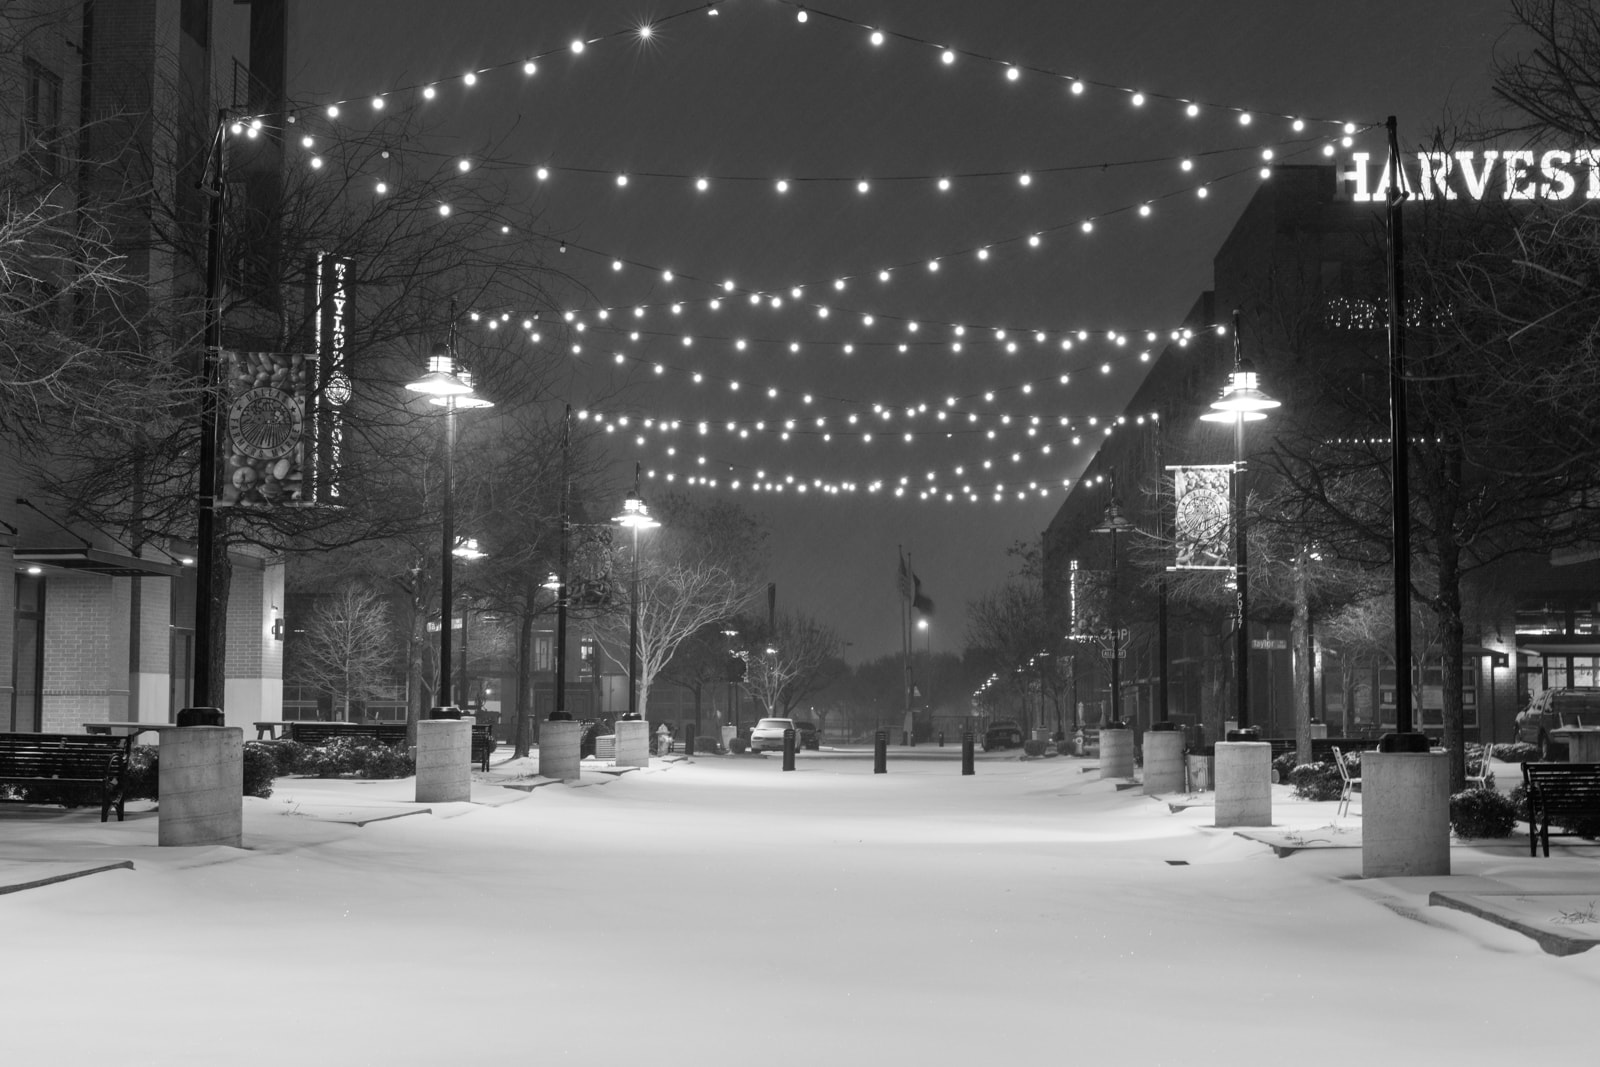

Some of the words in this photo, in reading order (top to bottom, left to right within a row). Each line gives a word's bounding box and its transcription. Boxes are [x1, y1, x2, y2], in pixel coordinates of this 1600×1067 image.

[1335, 150, 1600, 201] HARVEST
[245, 388, 289, 404] DALLAS
[230, 418, 264, 458] FARMERS
[1252, 639, 1274, 649] Taylor
